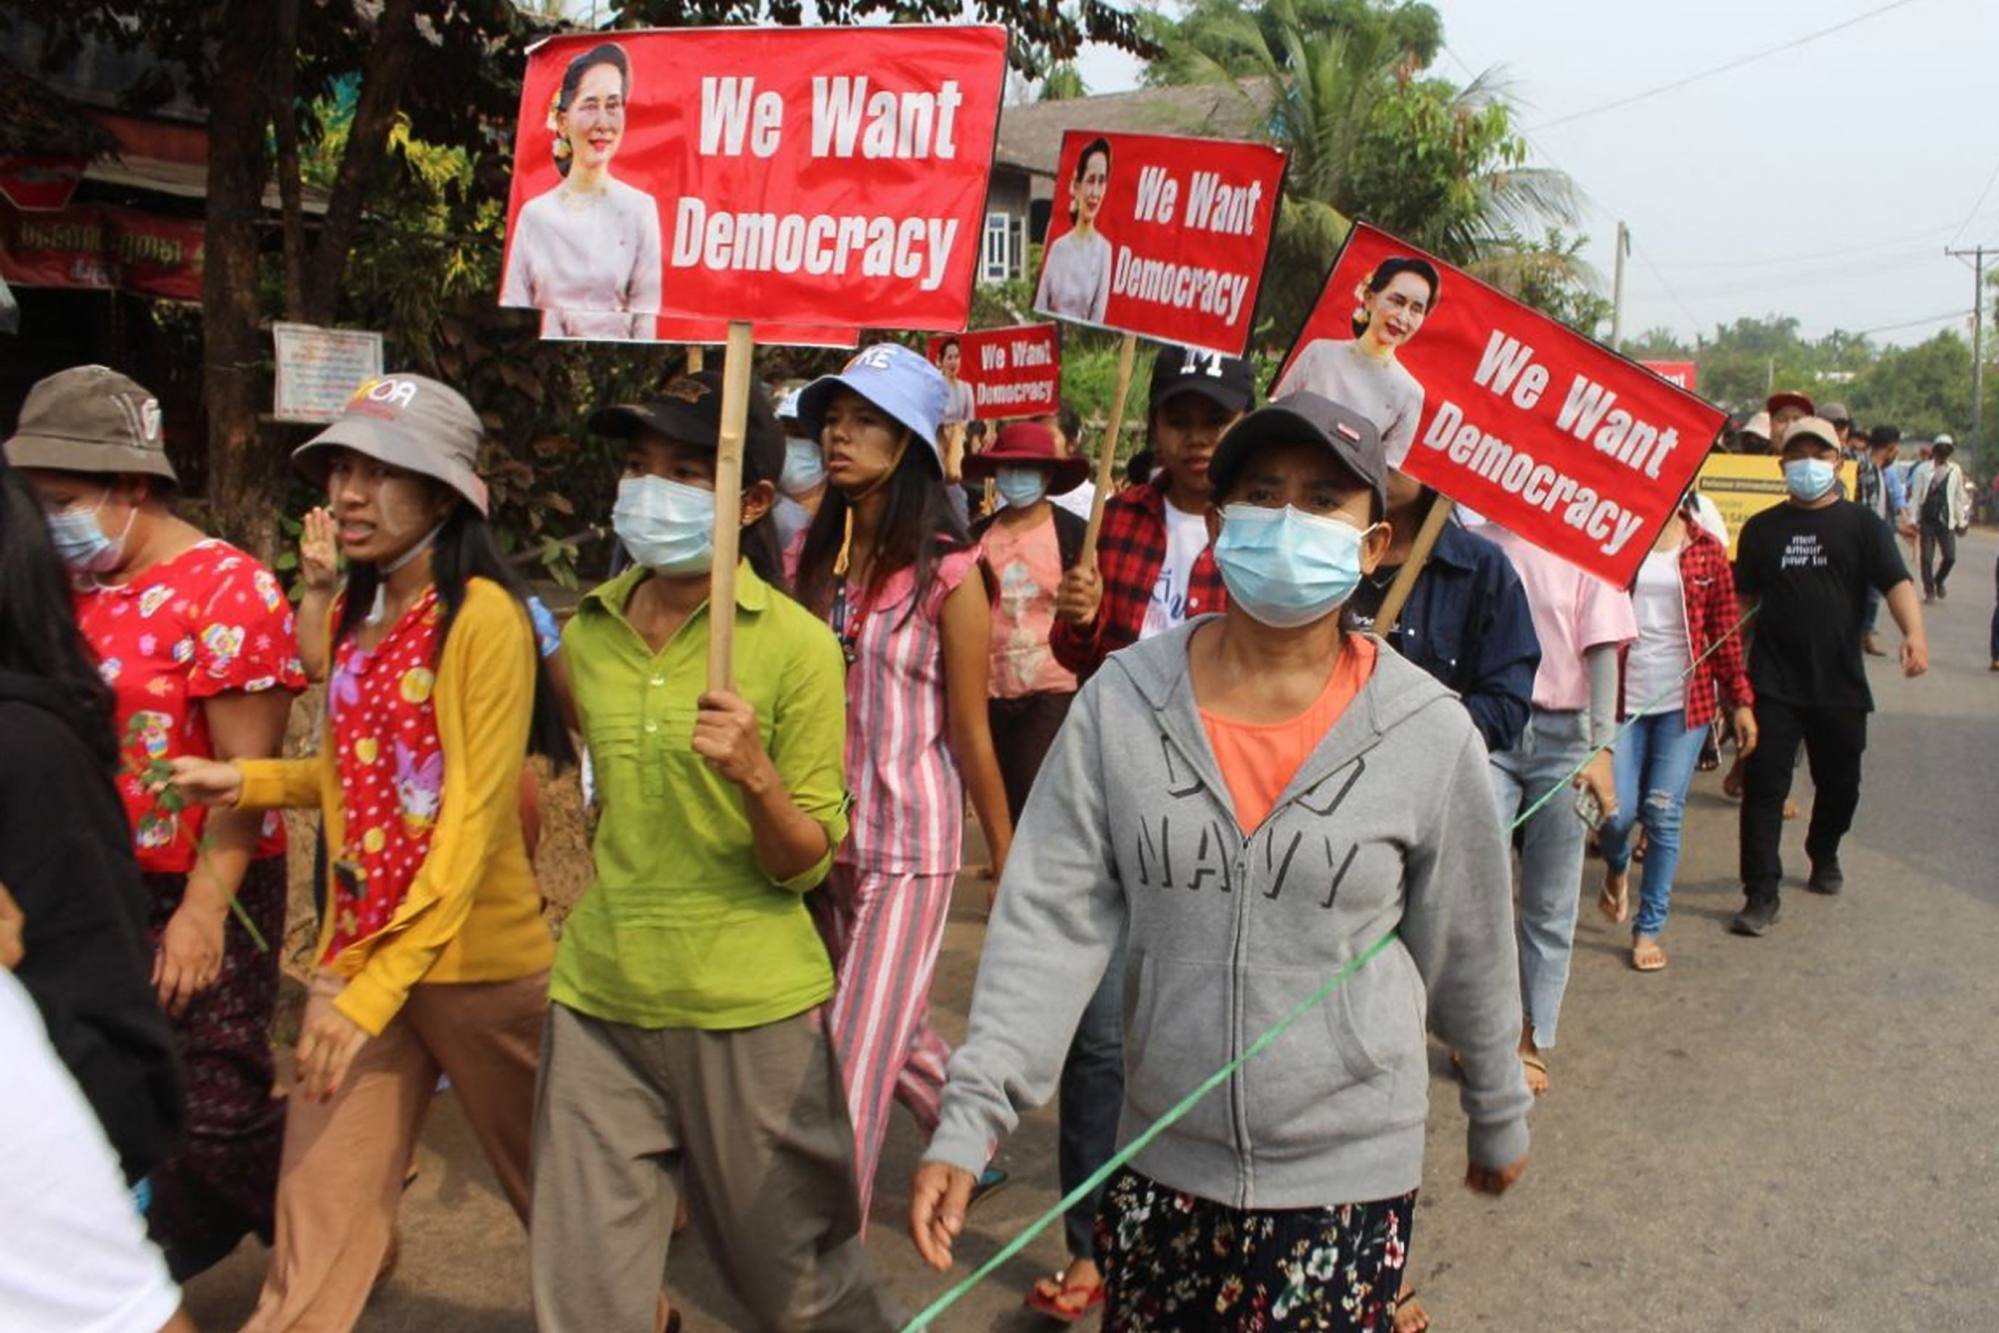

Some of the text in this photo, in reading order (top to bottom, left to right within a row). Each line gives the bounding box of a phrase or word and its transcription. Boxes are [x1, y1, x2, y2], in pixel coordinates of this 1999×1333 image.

[699, 75, 962, 160] We Want
[1134, 166, 1262, 236] We Want
[671, 196, 958, 292] Democracy
[1113, 246, 1248, 327] Democracy
[976, 380, 1054, 405] Democracy
[981, 340, 1052, 371] We Want
[1473, 329, 1678, 480] We Want
[1422, 401, 1645, 557] Democracy
[1136, 812, 1360, 909] NAVY
